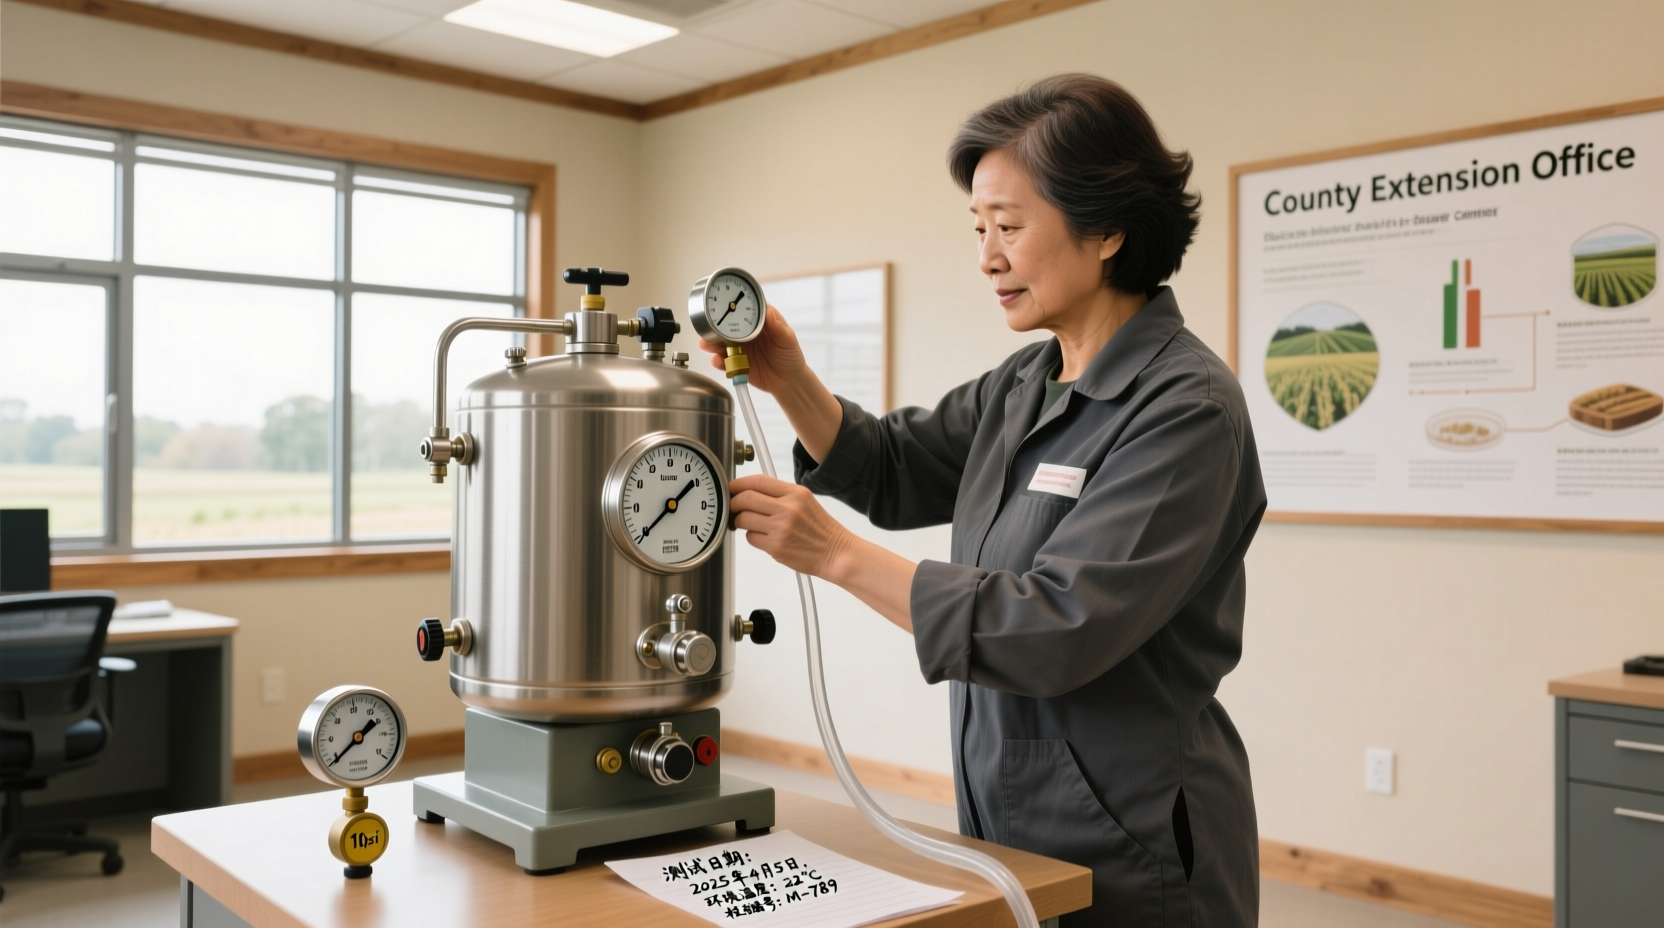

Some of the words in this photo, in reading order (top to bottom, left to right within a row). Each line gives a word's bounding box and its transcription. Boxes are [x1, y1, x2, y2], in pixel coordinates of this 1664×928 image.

[1263, 183, 1361, 216] County
[1371, 159, 1520, 202] Extension
[1531, 142, 1636, 180] Office
[785, 879, 838, 903] M-789
